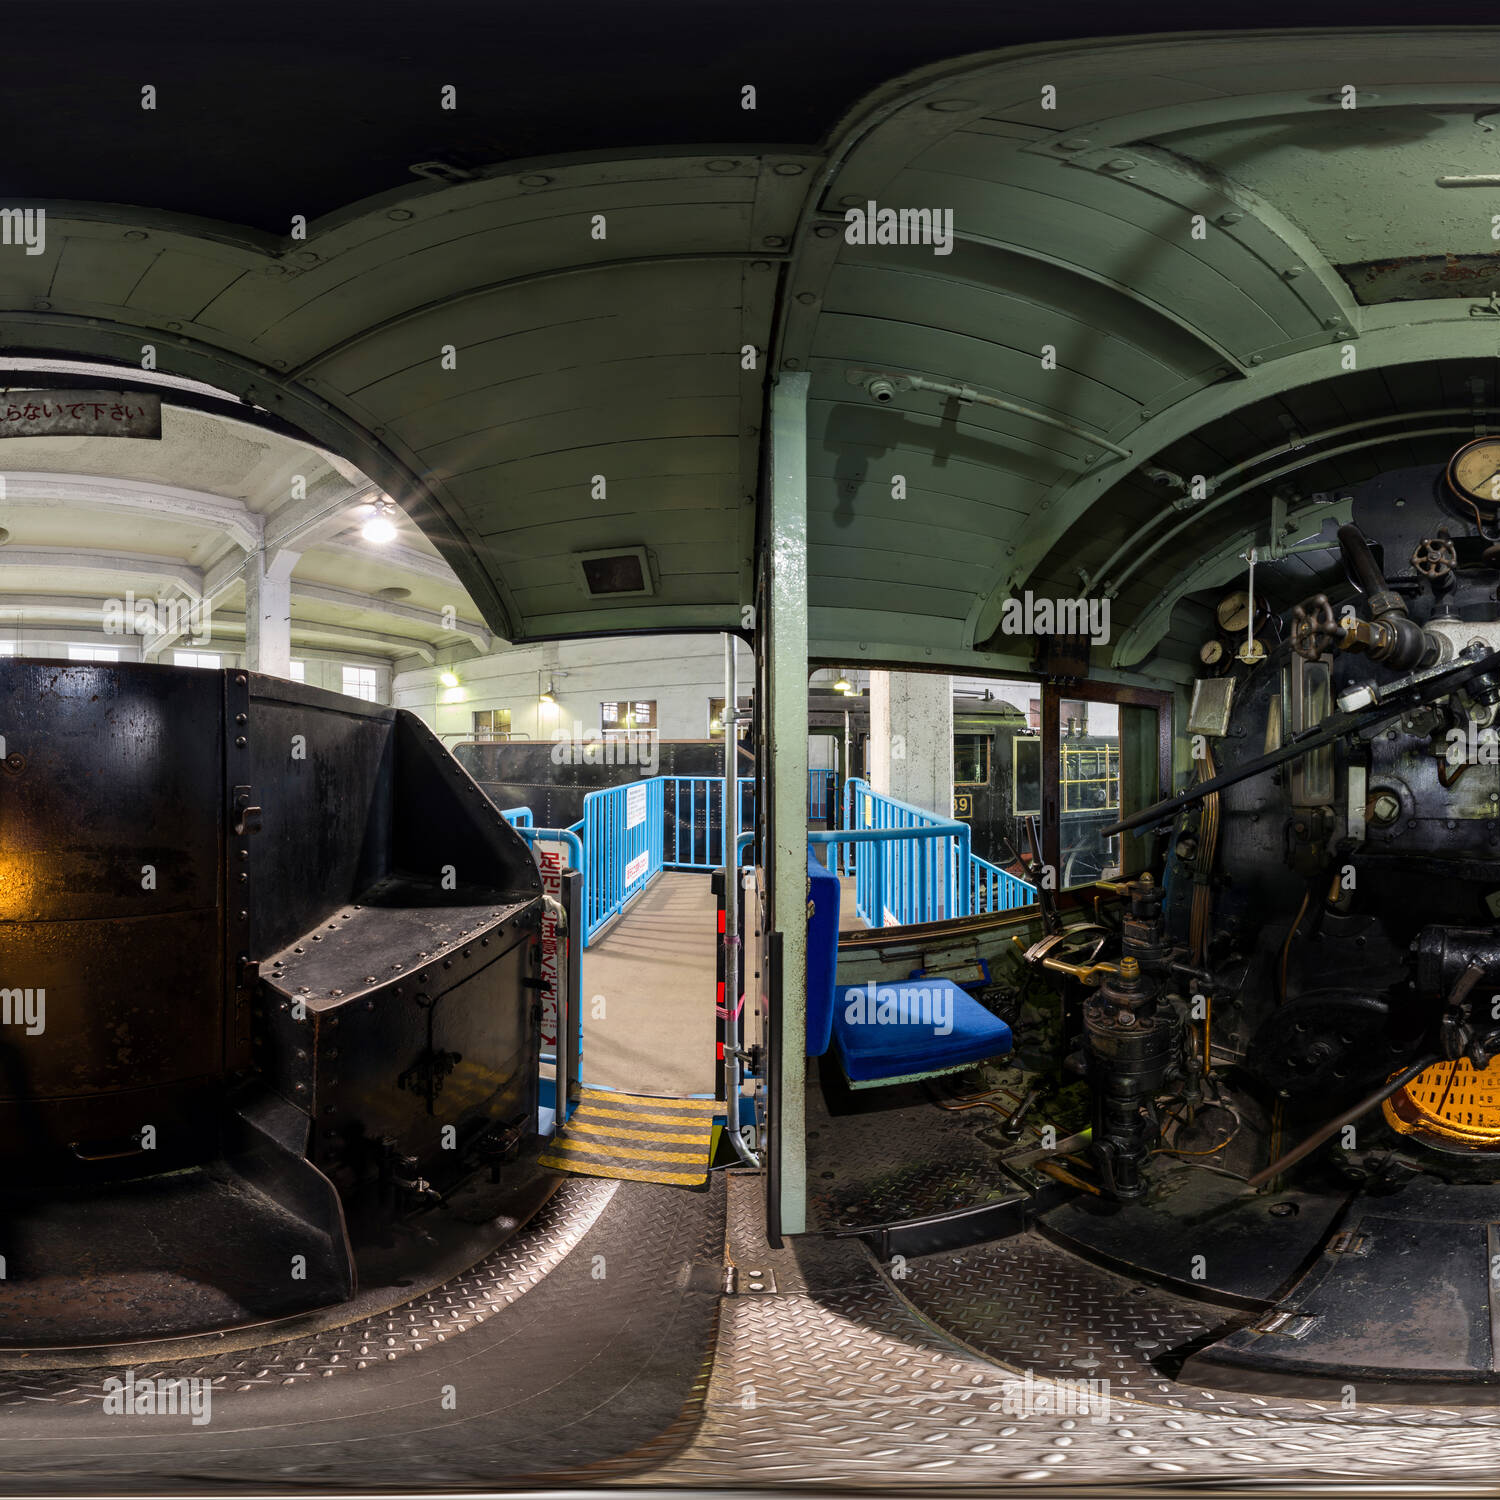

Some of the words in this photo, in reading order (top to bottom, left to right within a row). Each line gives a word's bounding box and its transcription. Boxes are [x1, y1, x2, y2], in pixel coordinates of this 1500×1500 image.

[0, 403, 145, 422] らないで下さい
